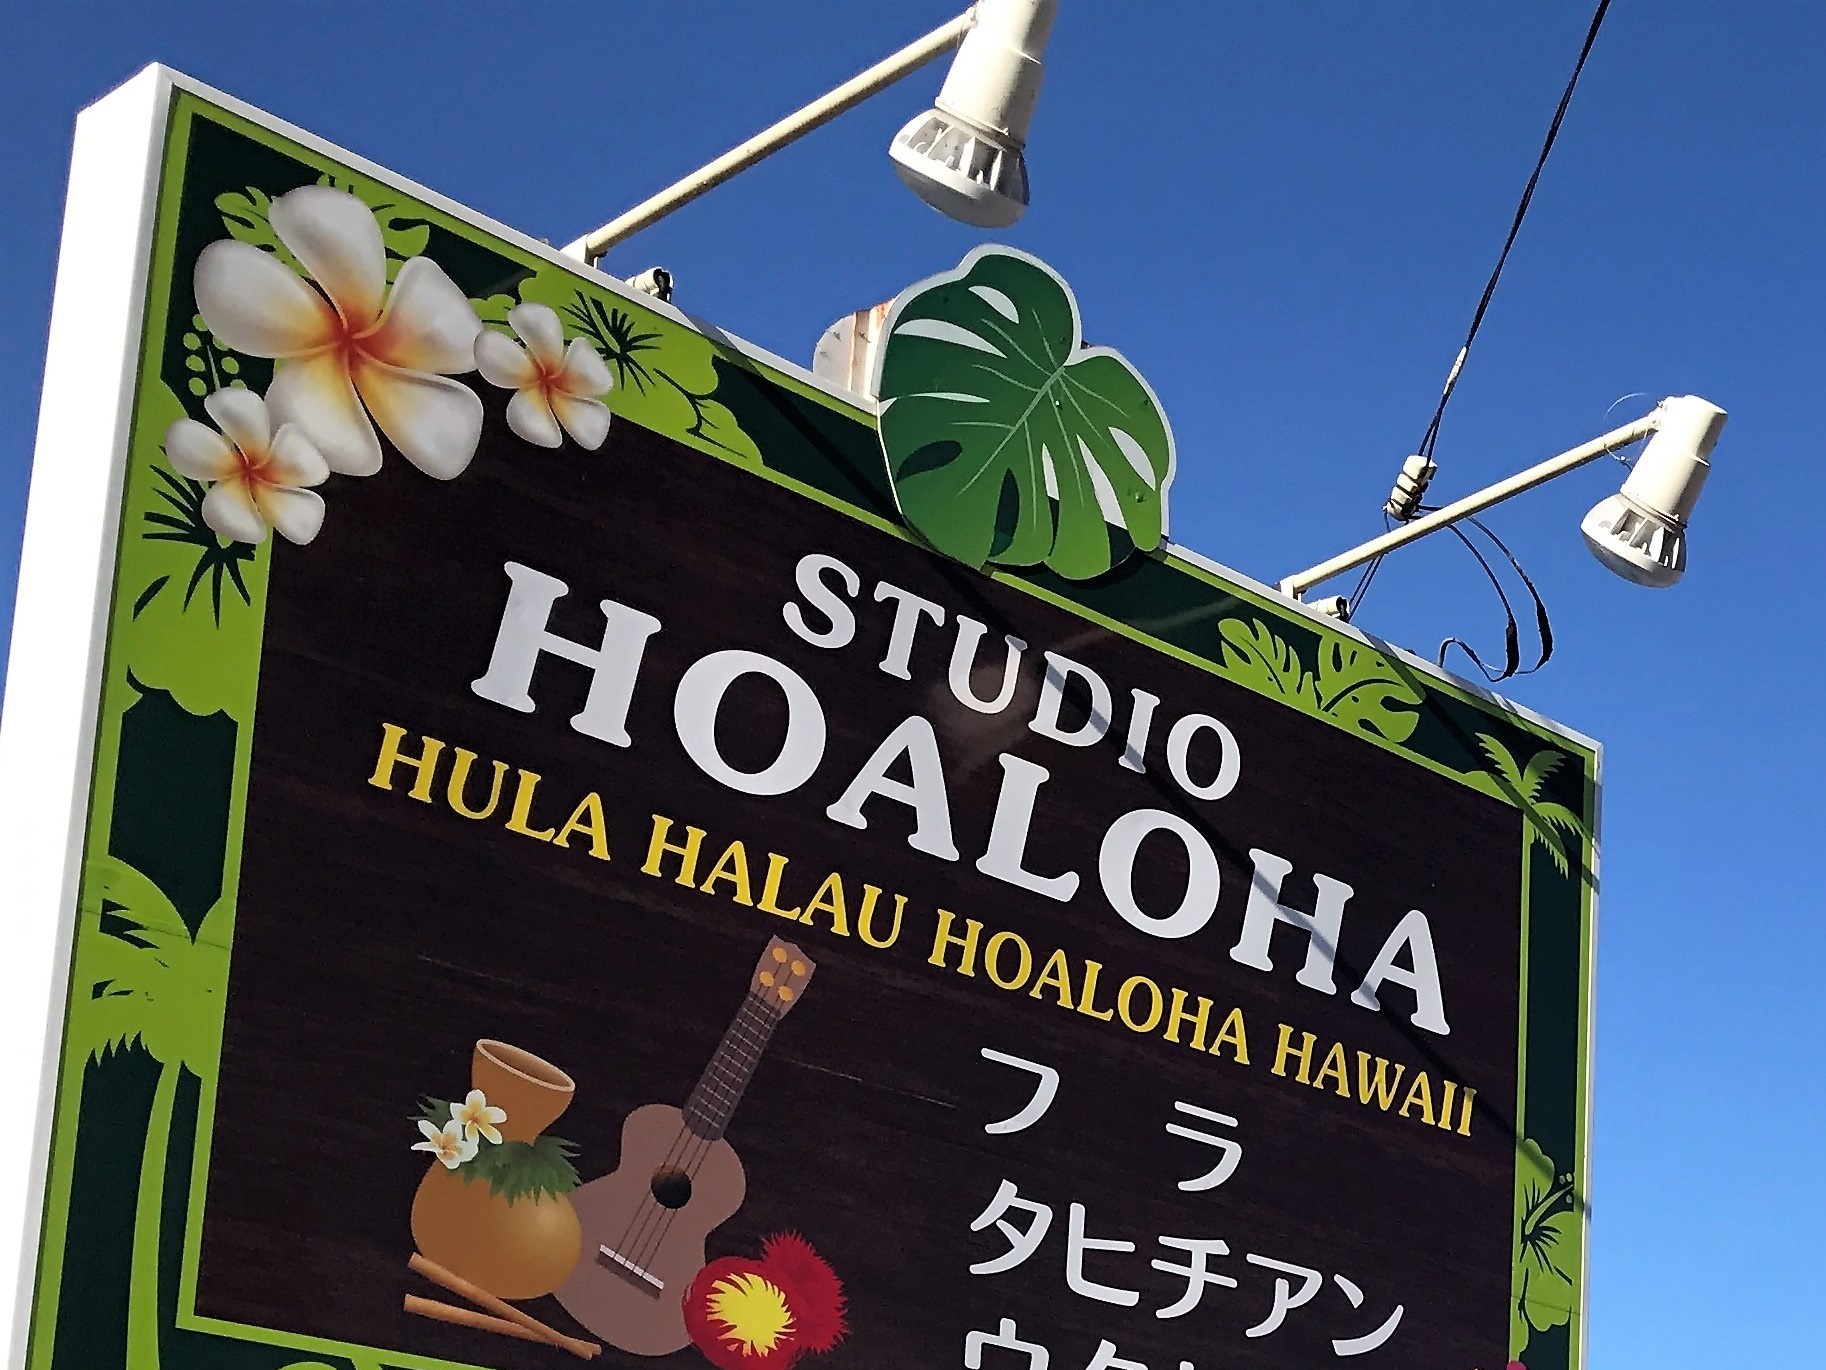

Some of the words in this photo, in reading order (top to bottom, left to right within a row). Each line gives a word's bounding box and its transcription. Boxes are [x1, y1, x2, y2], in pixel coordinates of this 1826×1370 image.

[470, 560, 1451, 1036] HOALOHA
[782, 553, 1242, 801] STUDIO
[367, 722, 610, 861] HULA
[641, 813, 908, 949] HALAU
[928, 908, 1252, 1066] HOALOHA
[1271, 1024, 1476, 1138] HAWAII
[968, 1178, 1405, 1358] タヒチアン
